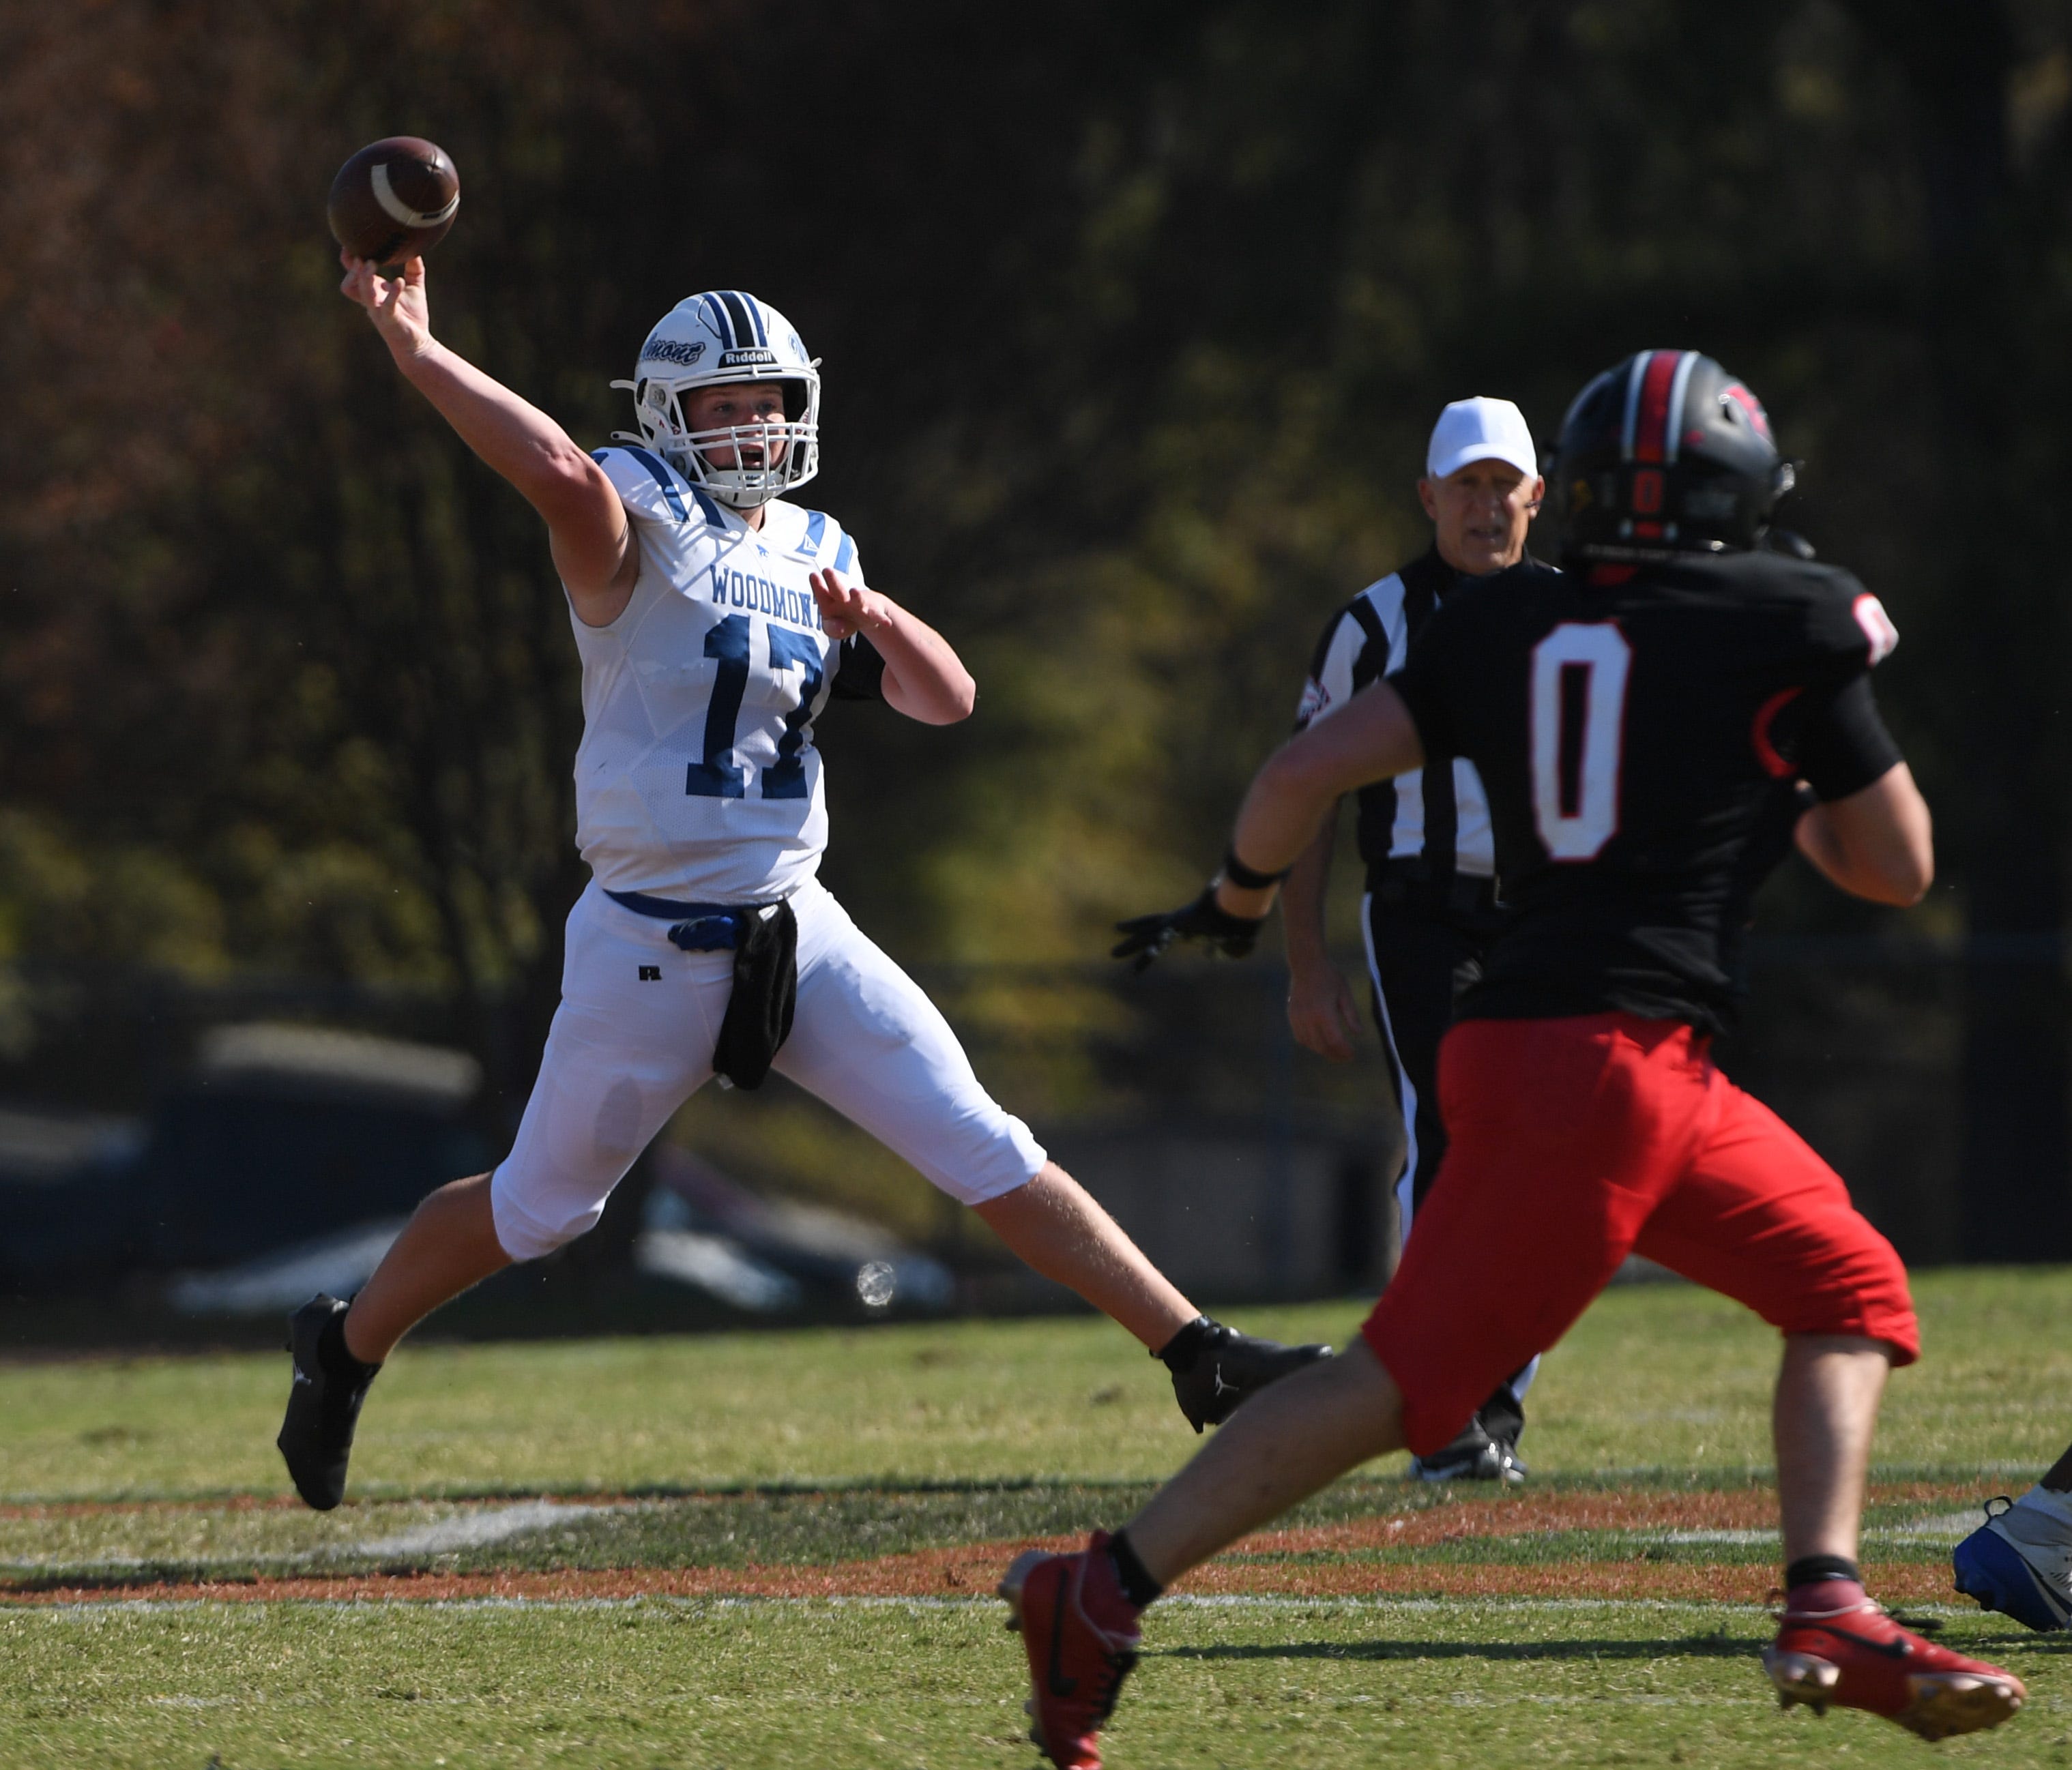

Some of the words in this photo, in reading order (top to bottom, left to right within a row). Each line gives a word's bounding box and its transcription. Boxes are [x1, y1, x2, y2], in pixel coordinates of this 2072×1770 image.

[686, 613, 823, 799] 17
[1529, 617, 1635, 863] 0
[639, 964, 662, 981] R
